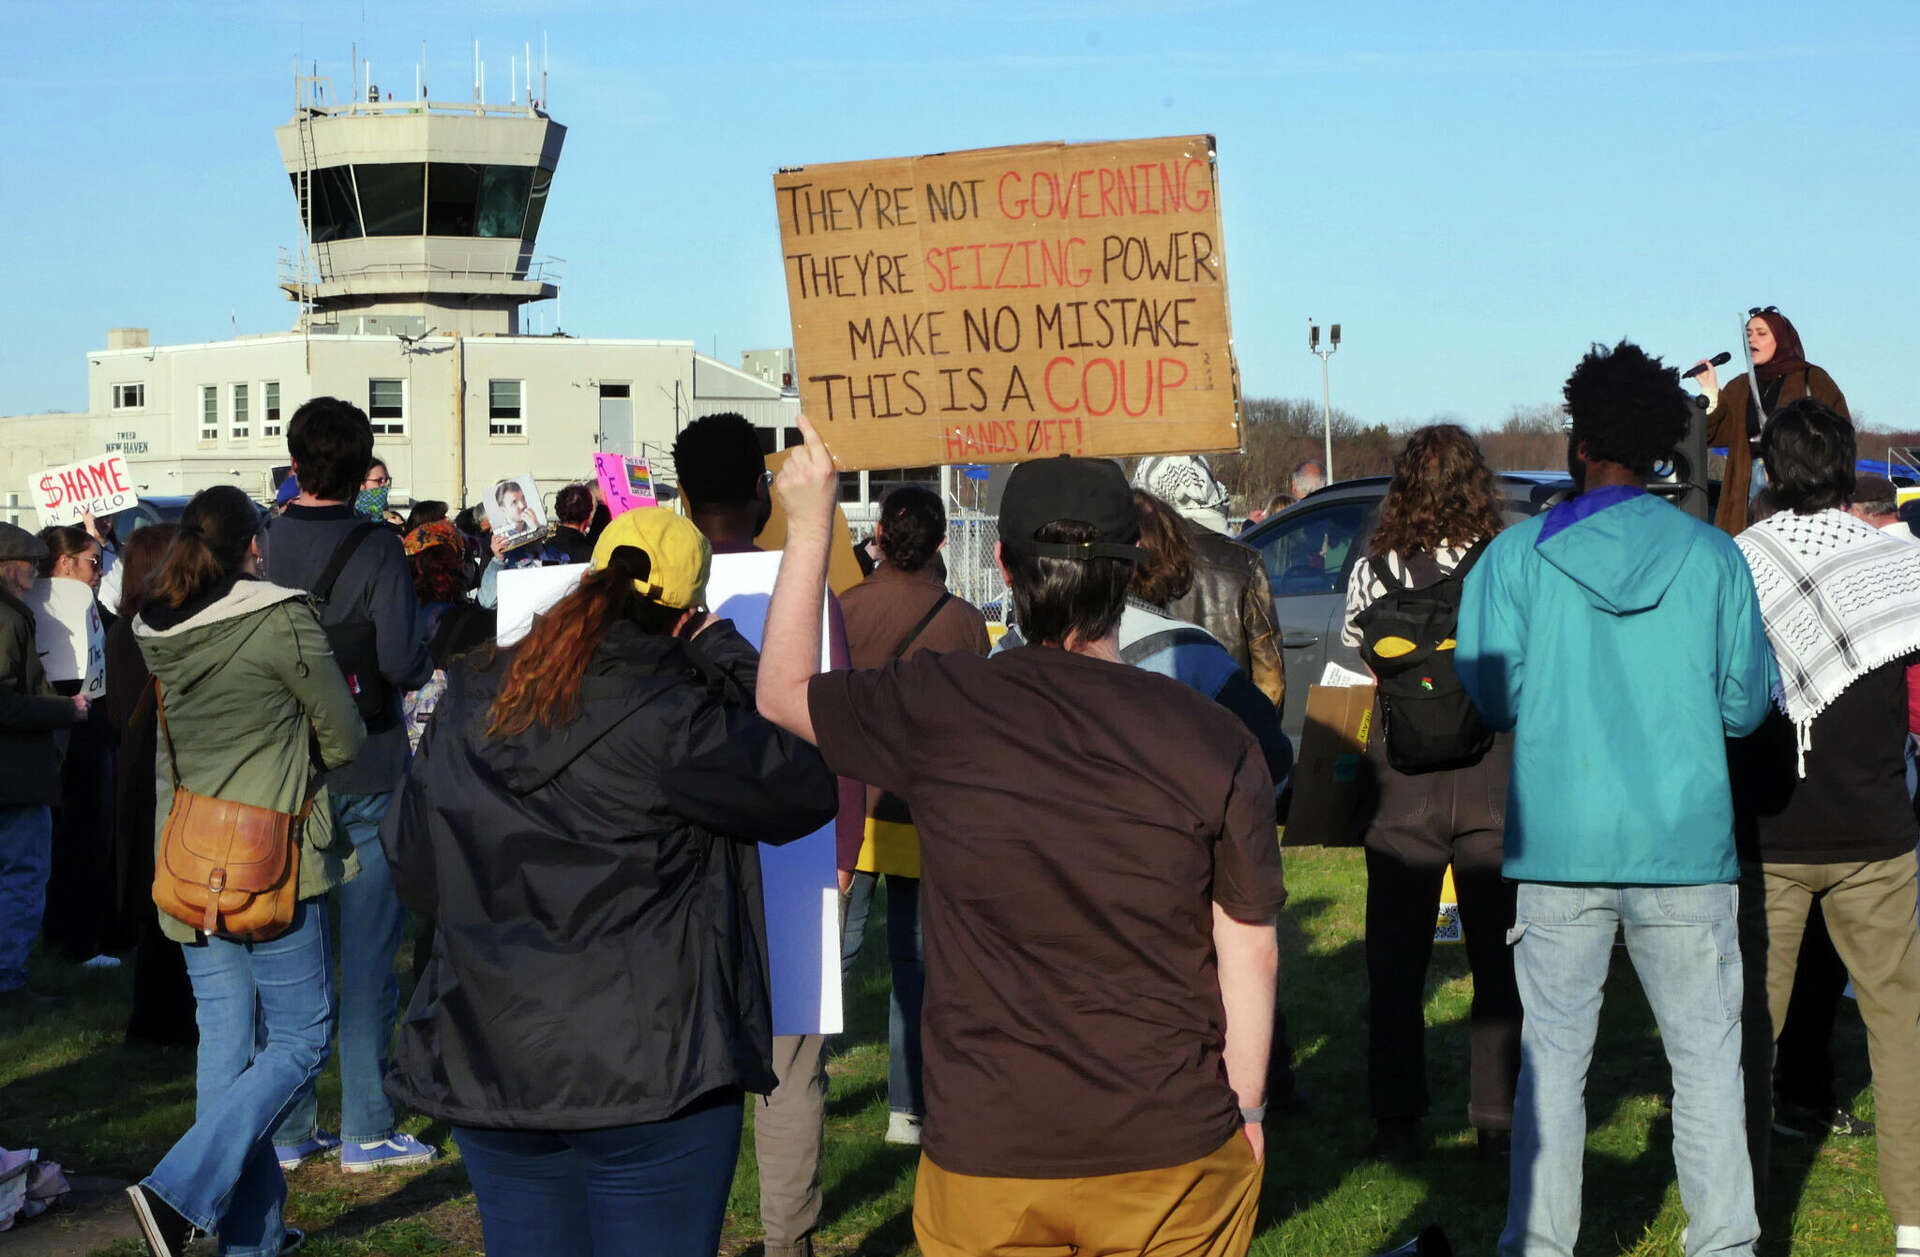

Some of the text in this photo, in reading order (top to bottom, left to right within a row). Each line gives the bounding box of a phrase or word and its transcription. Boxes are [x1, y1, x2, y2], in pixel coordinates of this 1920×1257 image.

[777, 159, 1210, 235] THEY'RE NOT GOVERNING
[786, 231, 1217, 299] THEY'RE SEIZING POWER
[849, 298, 1199, 360] MAKE NO MISTAKE
[808, 370, 927, 421] THIS
[939, 367, 988, 412] IS
[1001, 365, 1035, 412] A
[1044, 356, 1189, 417] COUP
[105, 441, 148, 454] NEW HAVEN
[945, 420, 1019, 459] HANDS
